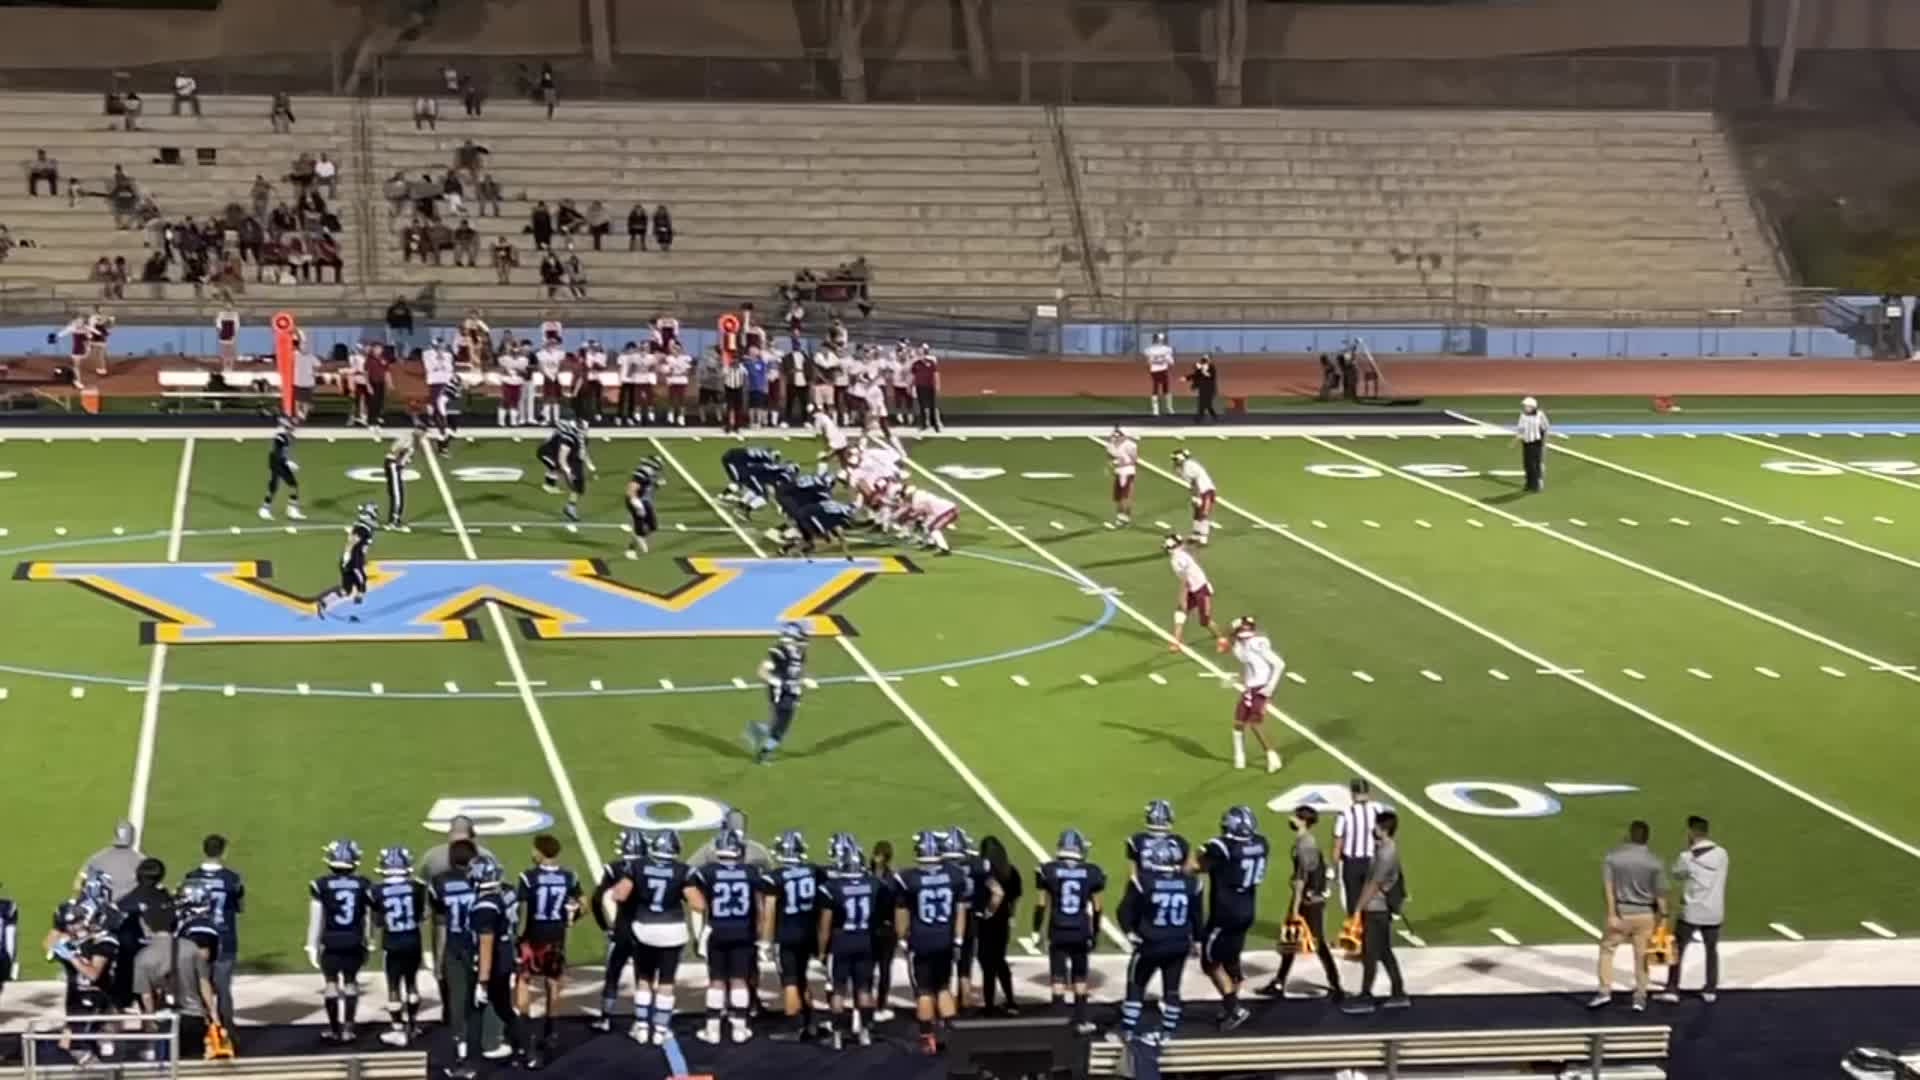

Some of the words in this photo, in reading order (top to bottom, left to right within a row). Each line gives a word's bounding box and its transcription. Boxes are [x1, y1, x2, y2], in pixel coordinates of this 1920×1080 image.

[333, 889, 355, 926] 3
[535, 885, 567, 920] 17
[647, 878, 667, 912] 7
[712, 881, 750, 917] 23
[784, 876, 816, 914] 19
[843, 895, 871, 931] 11
[918, 886, 953, 924] 63
[1061, 880, 1081, 914] 6
[1151, 893, 1189, 926] 70
[383, 895, 416, 933] 21
